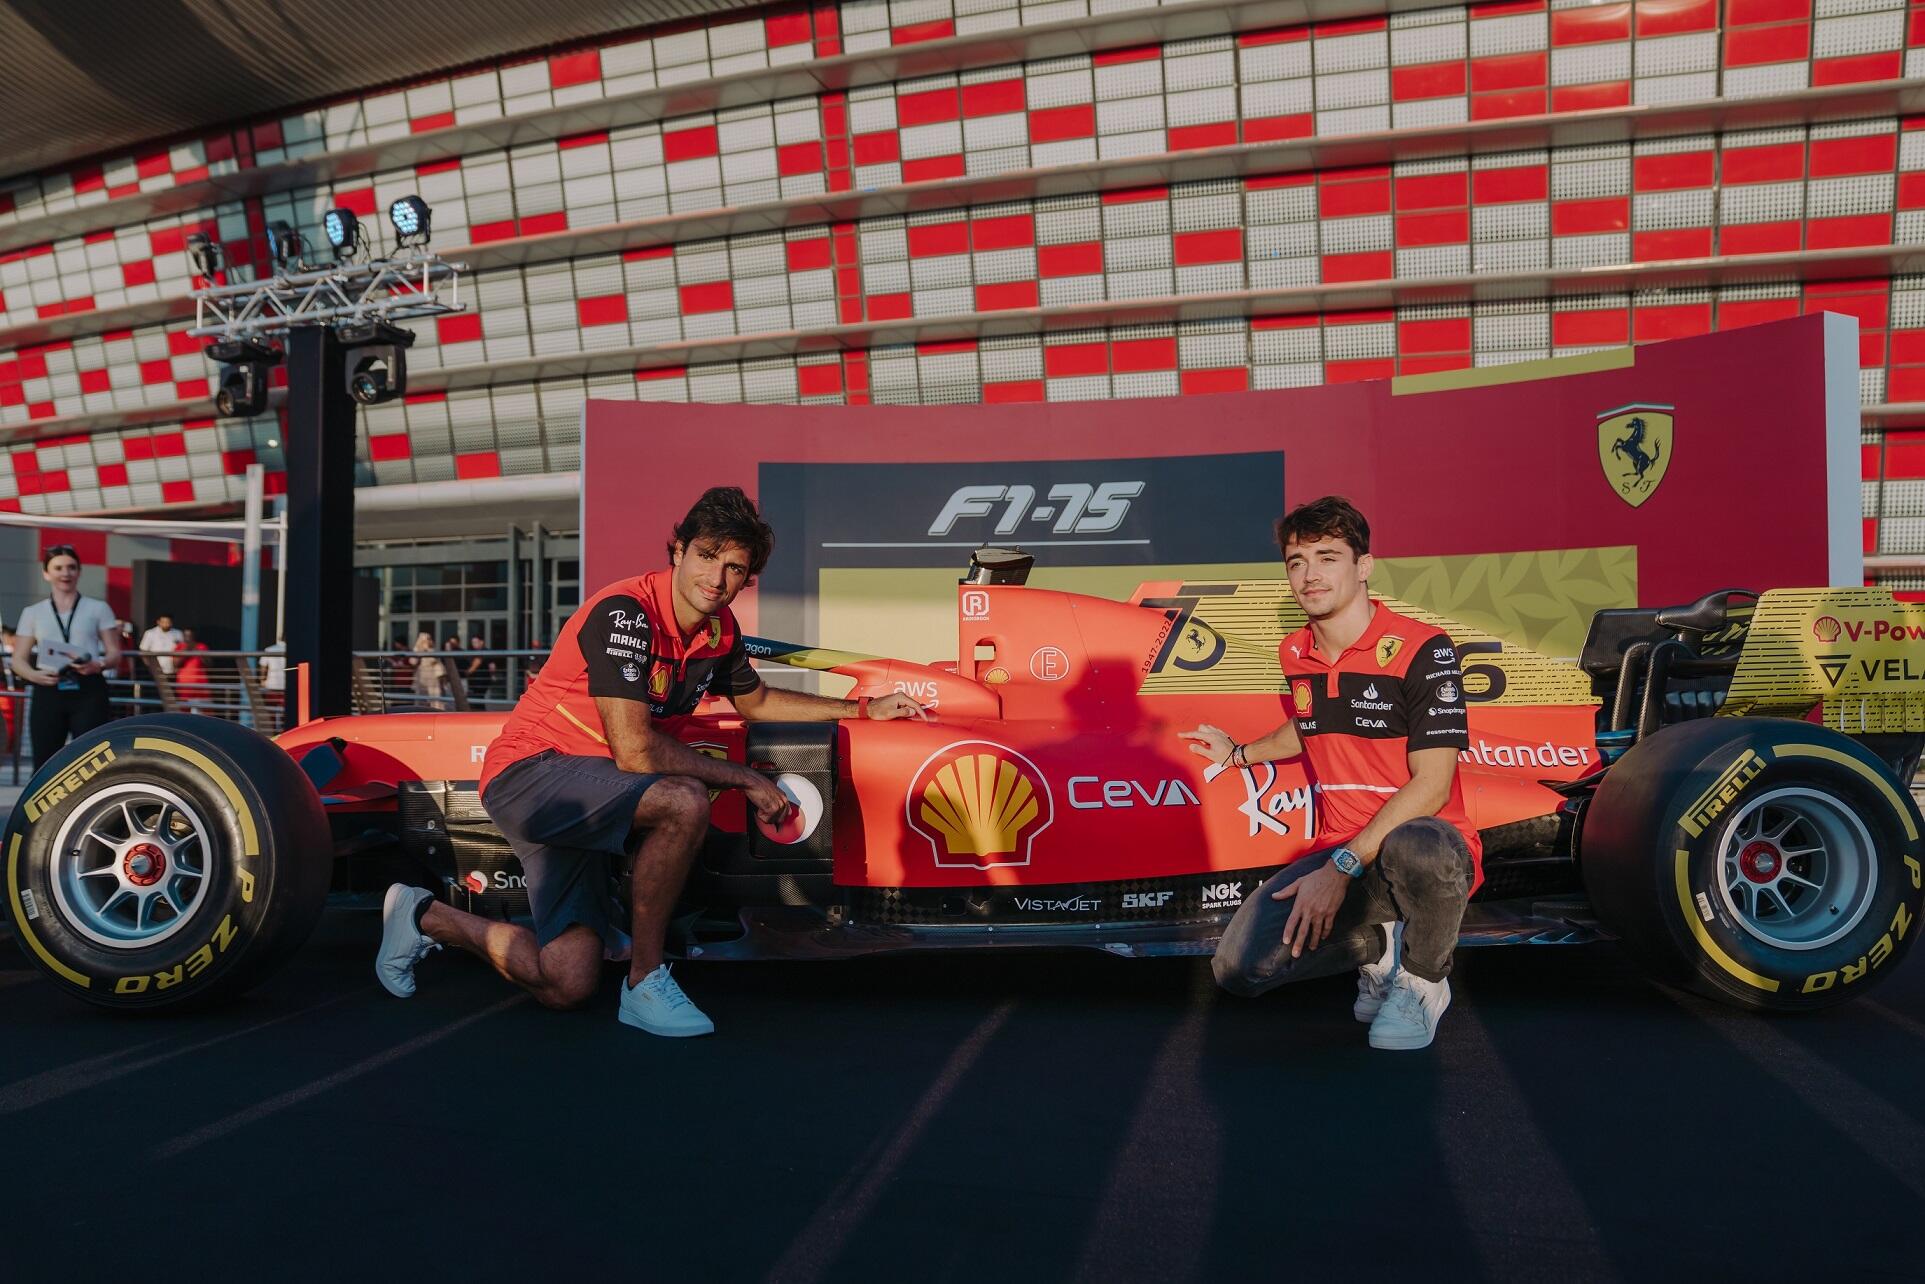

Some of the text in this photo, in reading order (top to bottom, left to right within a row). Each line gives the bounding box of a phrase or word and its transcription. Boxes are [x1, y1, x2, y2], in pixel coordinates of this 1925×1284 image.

[928, 481, 1146, 536] F1-75
[609, 632, 648, 651] MAHLE
[1141, 619, 1173, 674] 1947-2022
[1433, 647, 1454, 659] aws
[1425, 669, 1451, 680] RICHARD
[1860, 658, 1925, 682] VEL
[894, 681, 938, 698] aws
[1350, 698, 1394, 711] Santander
[1457, 740, 1589, 767] ntander
[24, 740, 117, 823] PIRELLI
[1678, 748, 1767, 840] PIRELLI
[1122, 891, 1173, 908] SKF
[1202, 880, 1242, 901] NGK
[1202, 899, 1242, 910] SPARK PLUGS
[114, 867, 255, 994] P ZERO
[1801, 854, 1922, 994] P ZERO
